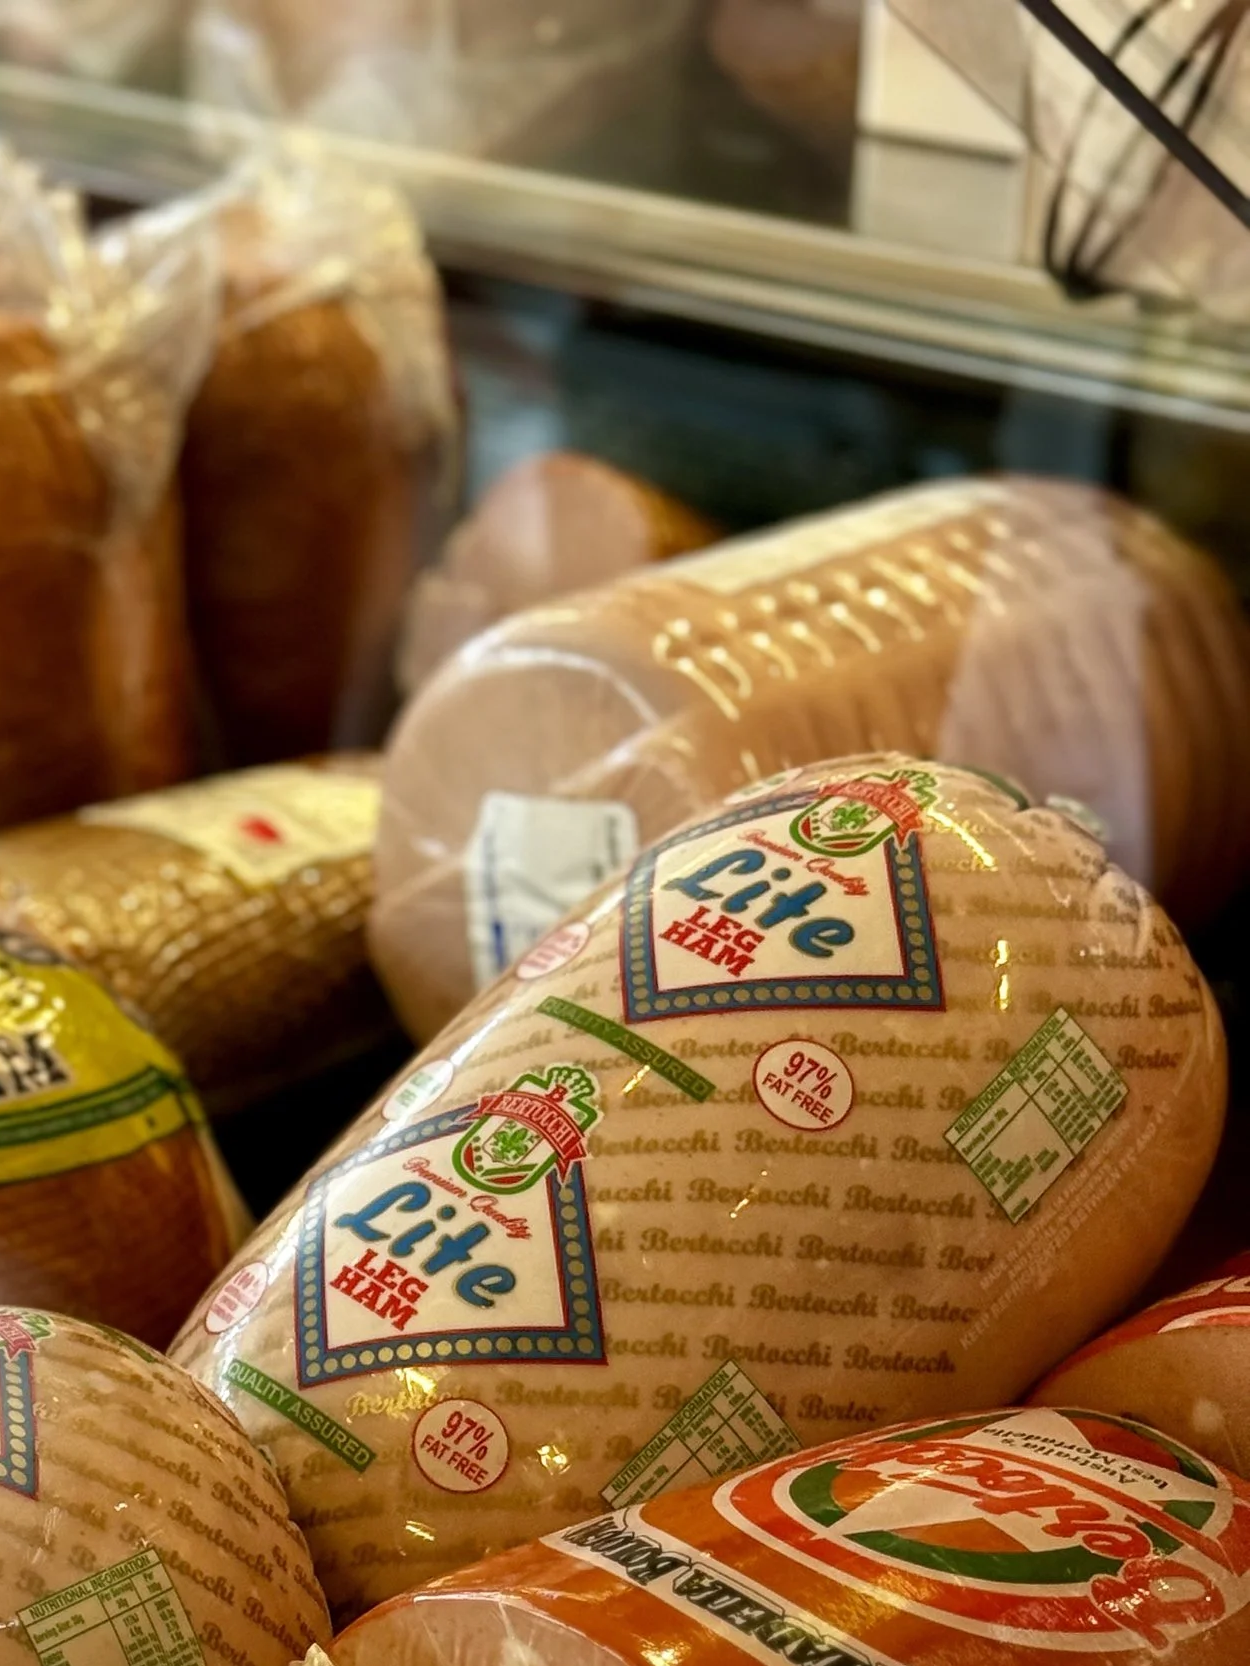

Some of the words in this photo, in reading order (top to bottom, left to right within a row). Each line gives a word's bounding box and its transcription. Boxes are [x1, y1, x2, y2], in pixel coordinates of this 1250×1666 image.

[661, 849, 855, 958] Lite
[684, 905, 765, 954] LEG
[658, 920, 755, 978] HAM
[614, 1033, 710, 1096] ASSURED
[671, 1038, 766, 1058] Bertoc
[762, 1071, 793, 1097] FAT
[790, 1088, 836, 1125] FREE
[782, 1050, 839, 1101] 97%
[495, 1095, 578, 1149] BERTOCCHI
[953, 1075, 1012, 1136] NUTRITIONAL
[734, 1128, 879, 1159] Bertocchi
[402, 1156, 467, 1198] Premium
[470, 1194, 532, 1240] Quality
[590, 1177, 674, 1204] tocchi
[844, 1184, 976, 1220] Bertocchi
[334, 1181, 516, 1308] Lite
[639, 1227, 785, 1258] Bertocchi
[796, 1233, 928, 1269] Bertocchi
[330, 1265, 419, 1331] HAM
[354, 1248, 430, 1304] LEG
[601, 1278, 737, 1308] Bertocchi
[748, 1284, 881, 1318] Bertocchi
[605, 1333, 689, 1359] tocchi
[701, 1333, 833, 1368] Bertocchi
[956, 1311, 996, 1351] KEEP
[227, 1360, 290, 1410] QUALITY
[287, 1401, 371, 1467] ASSURED
[440, 1410, 495, 1461] 97%
[611, 1432, 672, 1493] NUTRITIONAL
[668, 1369, 730, 1434] INFORMATION
[419, 1433, 448, 1460] FAT
[444, 1452, 490, 1487] FREE
[1000, 1437, 1139, 1485] Australia's
[1121, 1459, 1169, 1490] best
[167, 1500, 273, 1582] Bertocchi
[28, 1582, 92, 1621] NUTRITIONAL
[89, 1553, 152, 1591] INFORMATION
